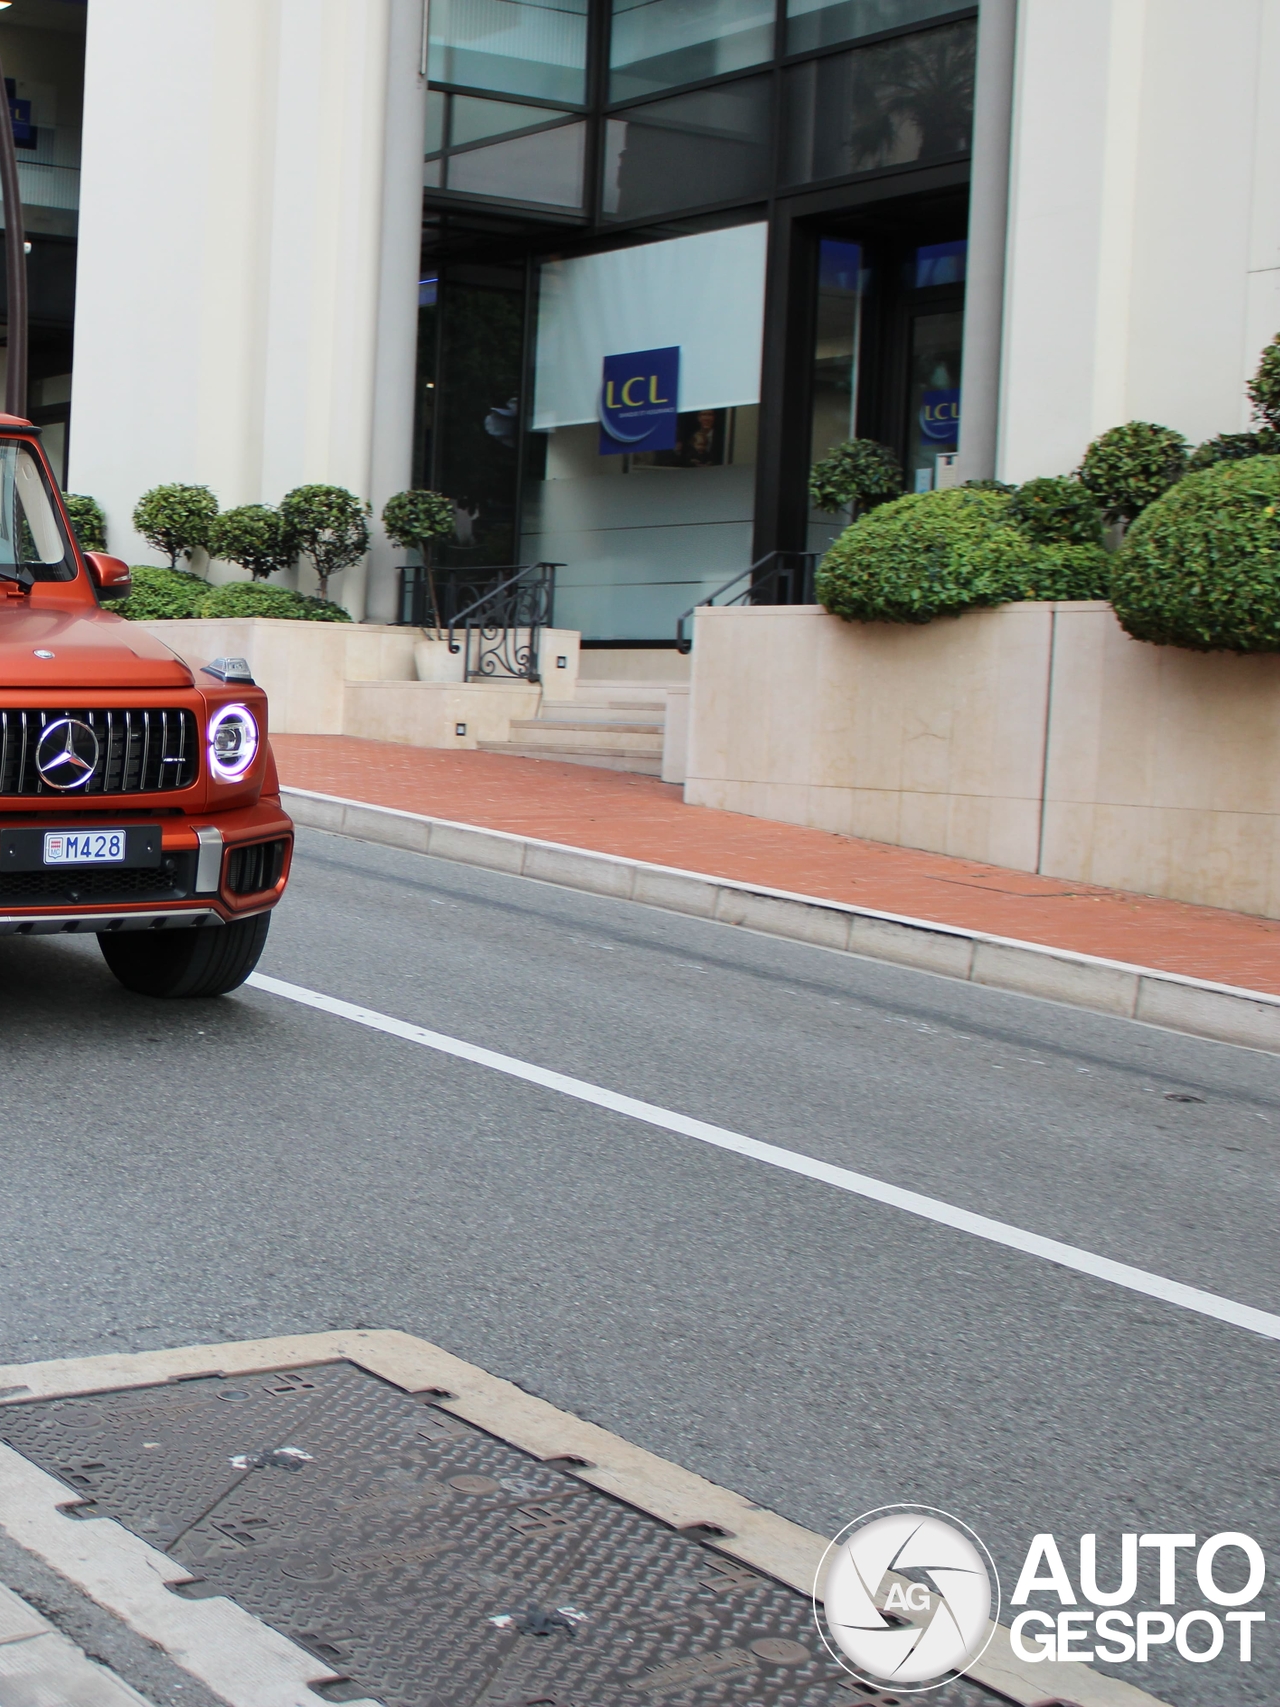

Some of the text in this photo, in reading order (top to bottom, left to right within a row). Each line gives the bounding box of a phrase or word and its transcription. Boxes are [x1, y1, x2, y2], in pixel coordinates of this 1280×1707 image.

[606, 375, 668, 408] LCL
[925, 403, 961, 421] LCL
[66, 835, 121, 858] M428
